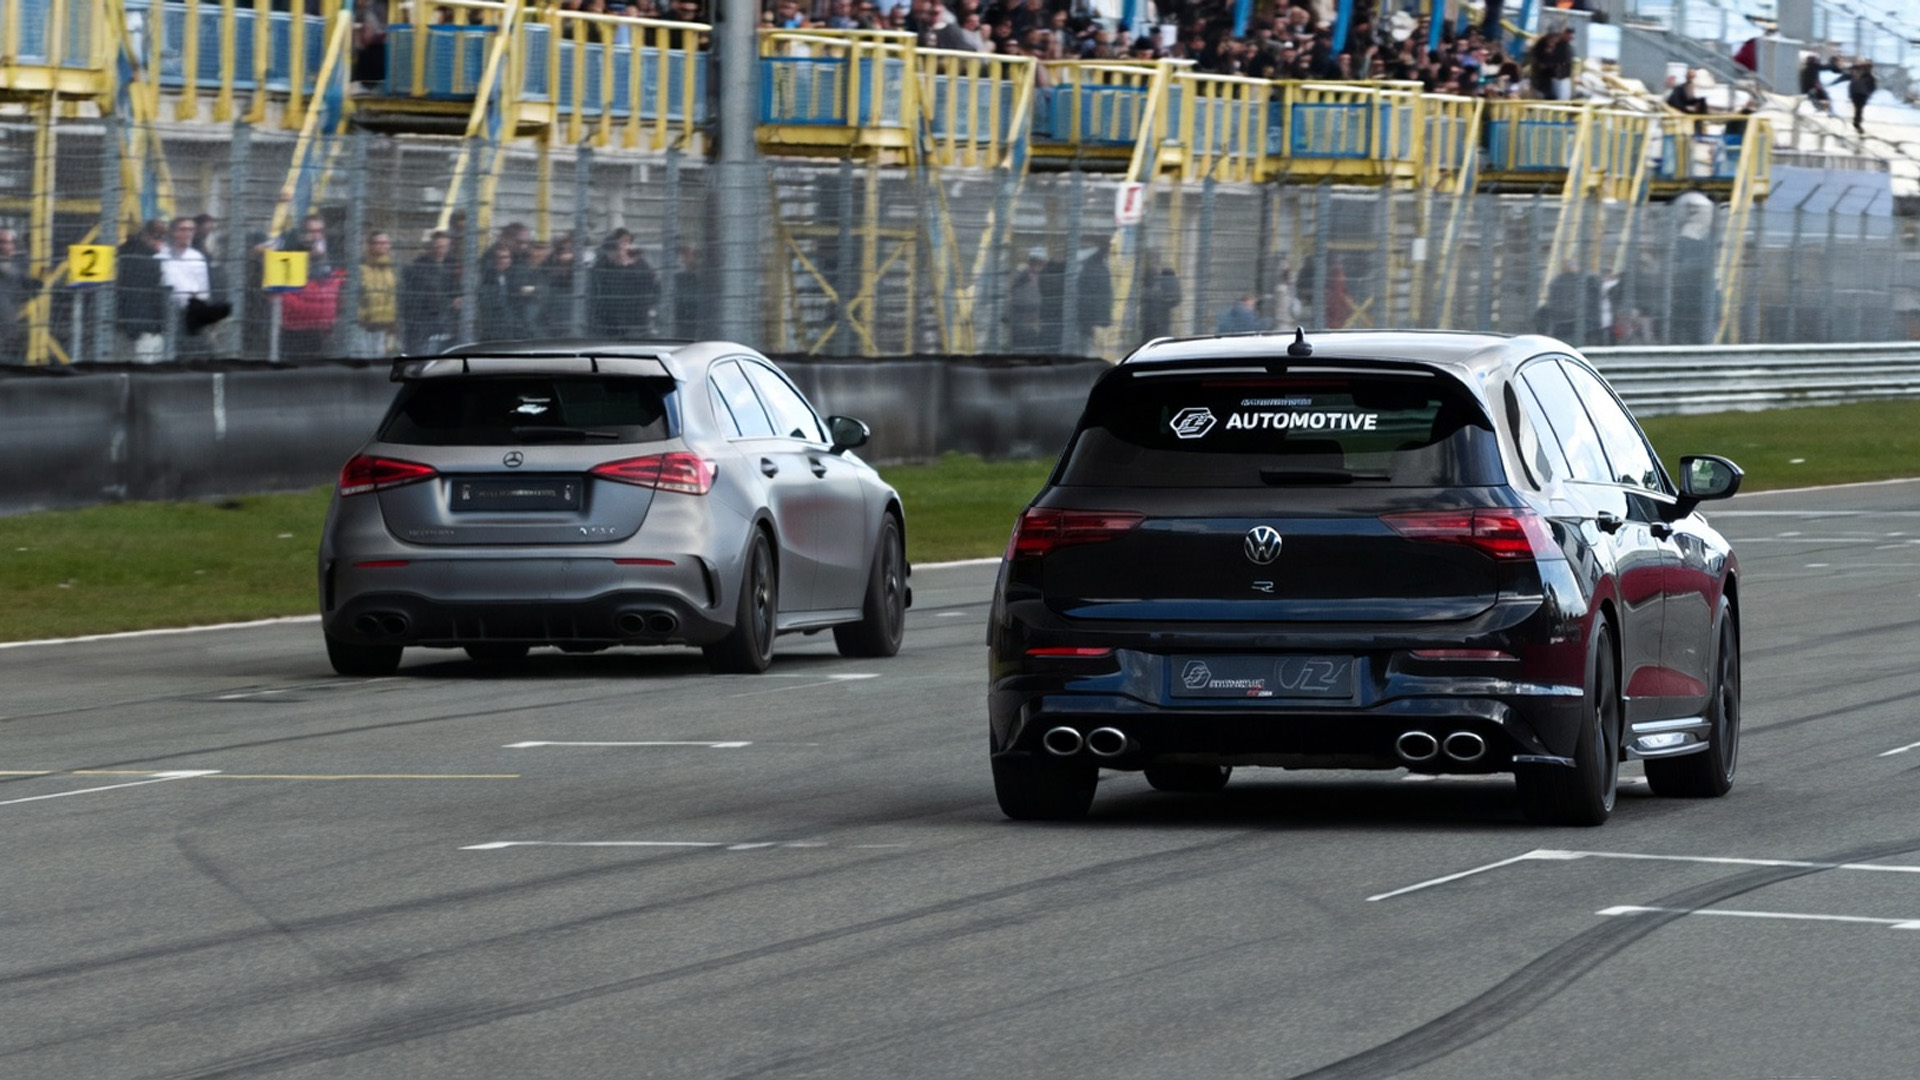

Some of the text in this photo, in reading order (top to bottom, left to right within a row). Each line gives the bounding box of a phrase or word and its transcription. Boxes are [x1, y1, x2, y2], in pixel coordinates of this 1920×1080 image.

[79, 249, 99, 277] 2
[280, 257, 292, 284] 1
[1225, 412, 1379, 431] AUTOMOTIVE
